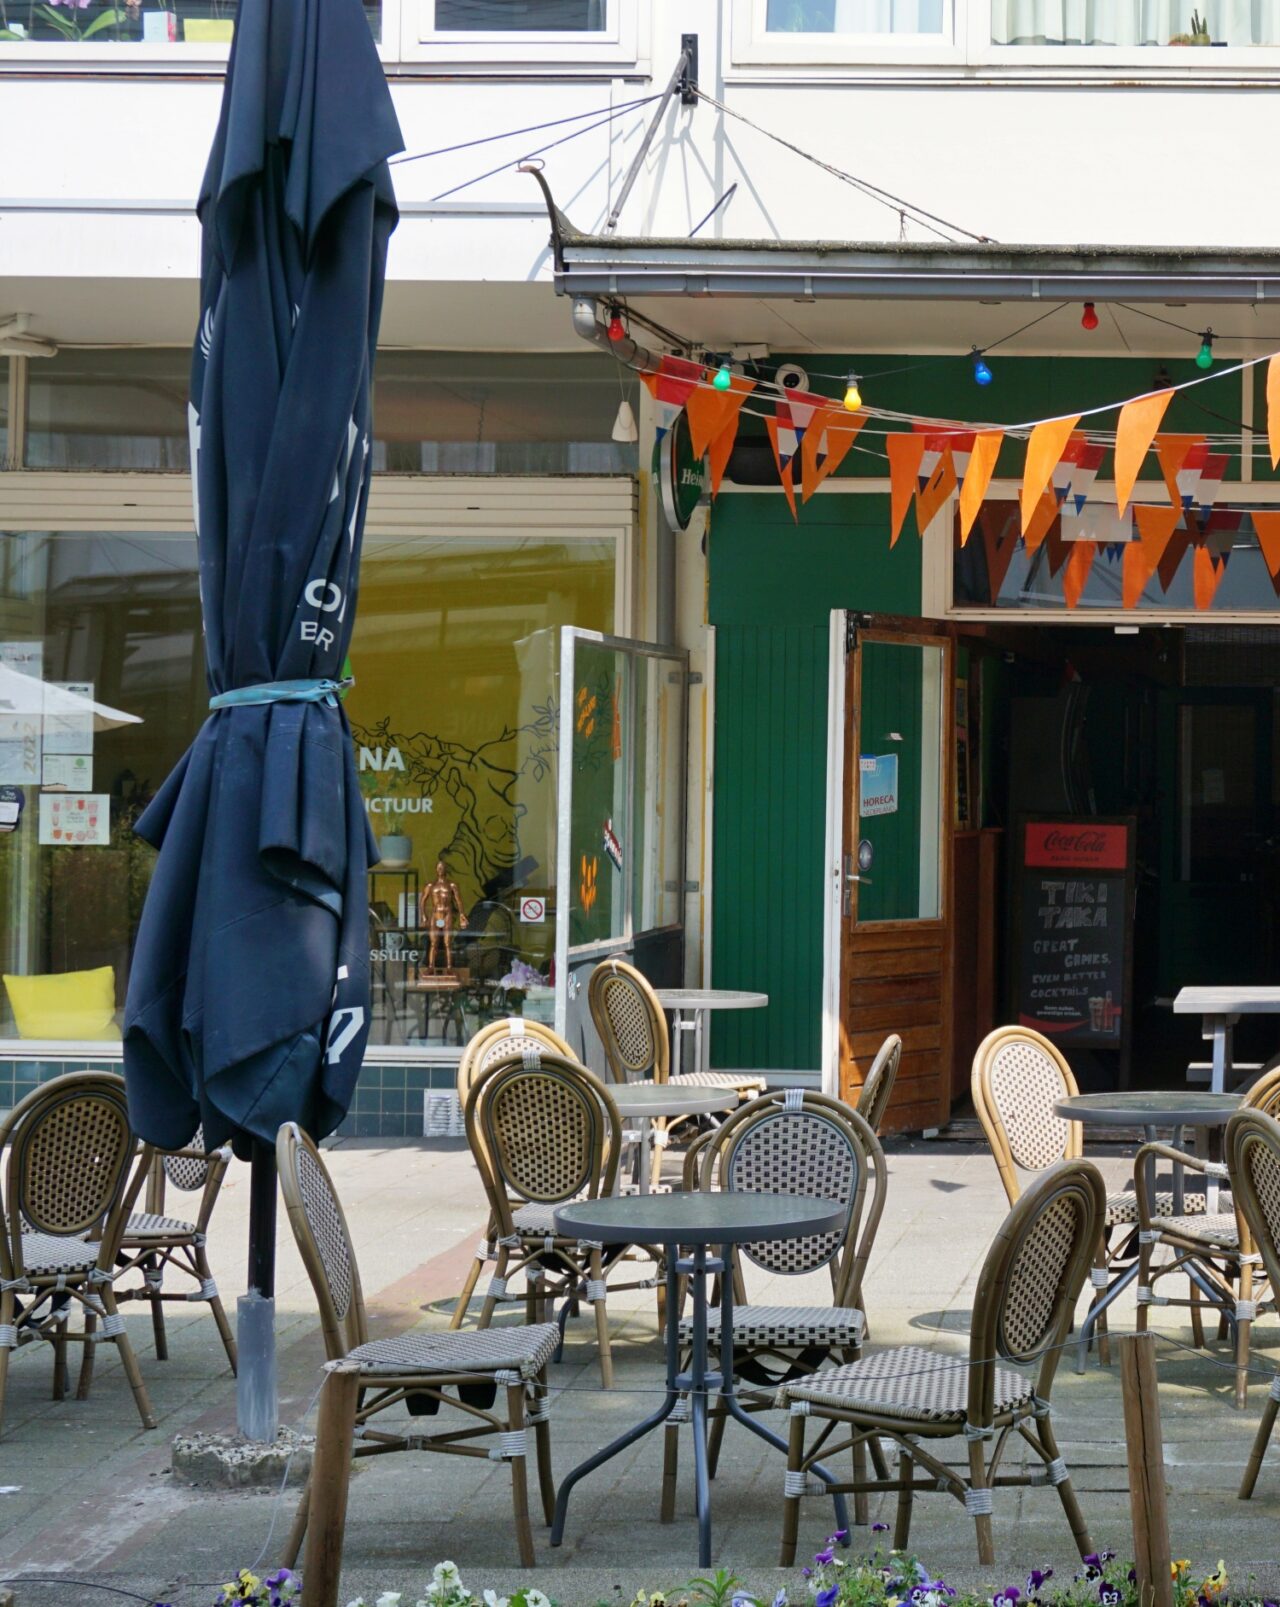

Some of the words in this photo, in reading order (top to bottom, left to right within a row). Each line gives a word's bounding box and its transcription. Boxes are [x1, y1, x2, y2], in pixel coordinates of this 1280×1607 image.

[863, 794, 895, 807] HORECA
[1043, 830, 1107, 852] Coca-Cola
[1041, 880, 1108, 905] TIKI
[1038, 906, 1108, 929] TAKA
[1033, 939, 1079, 954] GREAT
[1032, 973, 1060, 984] EVEN
[1063, 970, 1107, 982] BETTER
[1030, 986, 1089, 998] COCKTAILS
